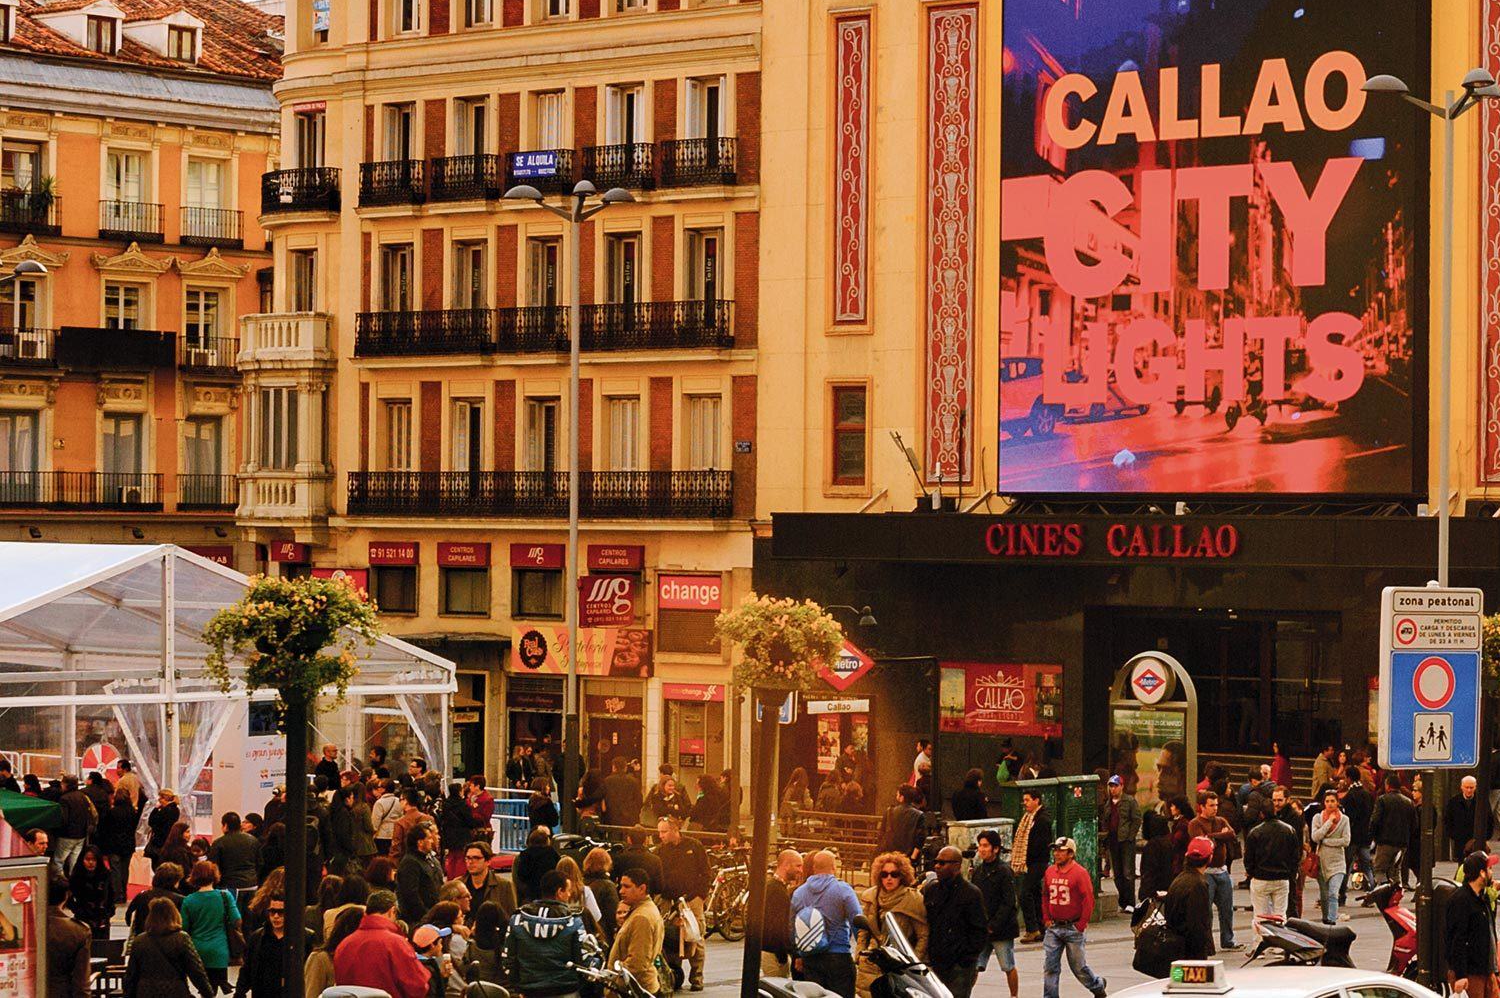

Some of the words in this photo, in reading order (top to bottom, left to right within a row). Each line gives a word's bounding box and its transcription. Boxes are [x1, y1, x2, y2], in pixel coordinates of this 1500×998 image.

[1045, 50, 1367, 150] CALLAO
[515, 155, 524, 167] SE
[527, 154, 554, 166] ALQUILA
[1043, 157, 1366, 299] CITY
[1042, 312, 1367, 405] LIGHTS
[985, 523, 1082, 556] CINES
[1106, 523, 1239, 558] CALLAO
[377, 548, 385, 558] 91
[386, 548, 397, 558] 521
[398, 548, 406, 558] 14
[450, 546, 474, 554] CENTROS
[447, 554, 476, 562] CAPILARES
[599, 557, 629, 565] CAPILARES
[661, 580, 720, 605] change
[1399, 596, 1424, 607] zona
[1427, 596, 1475, 608] peatonal
[835, 657, 858, 670] etro
[1141, 677, 1157, 686] Metro
[975, 687, 1025, 710] CALLAO
[827, 702, 851, 712] Callao
[1049, 885, 1070, 906] 23
[1183, 967, 1208, 982] TAXI
